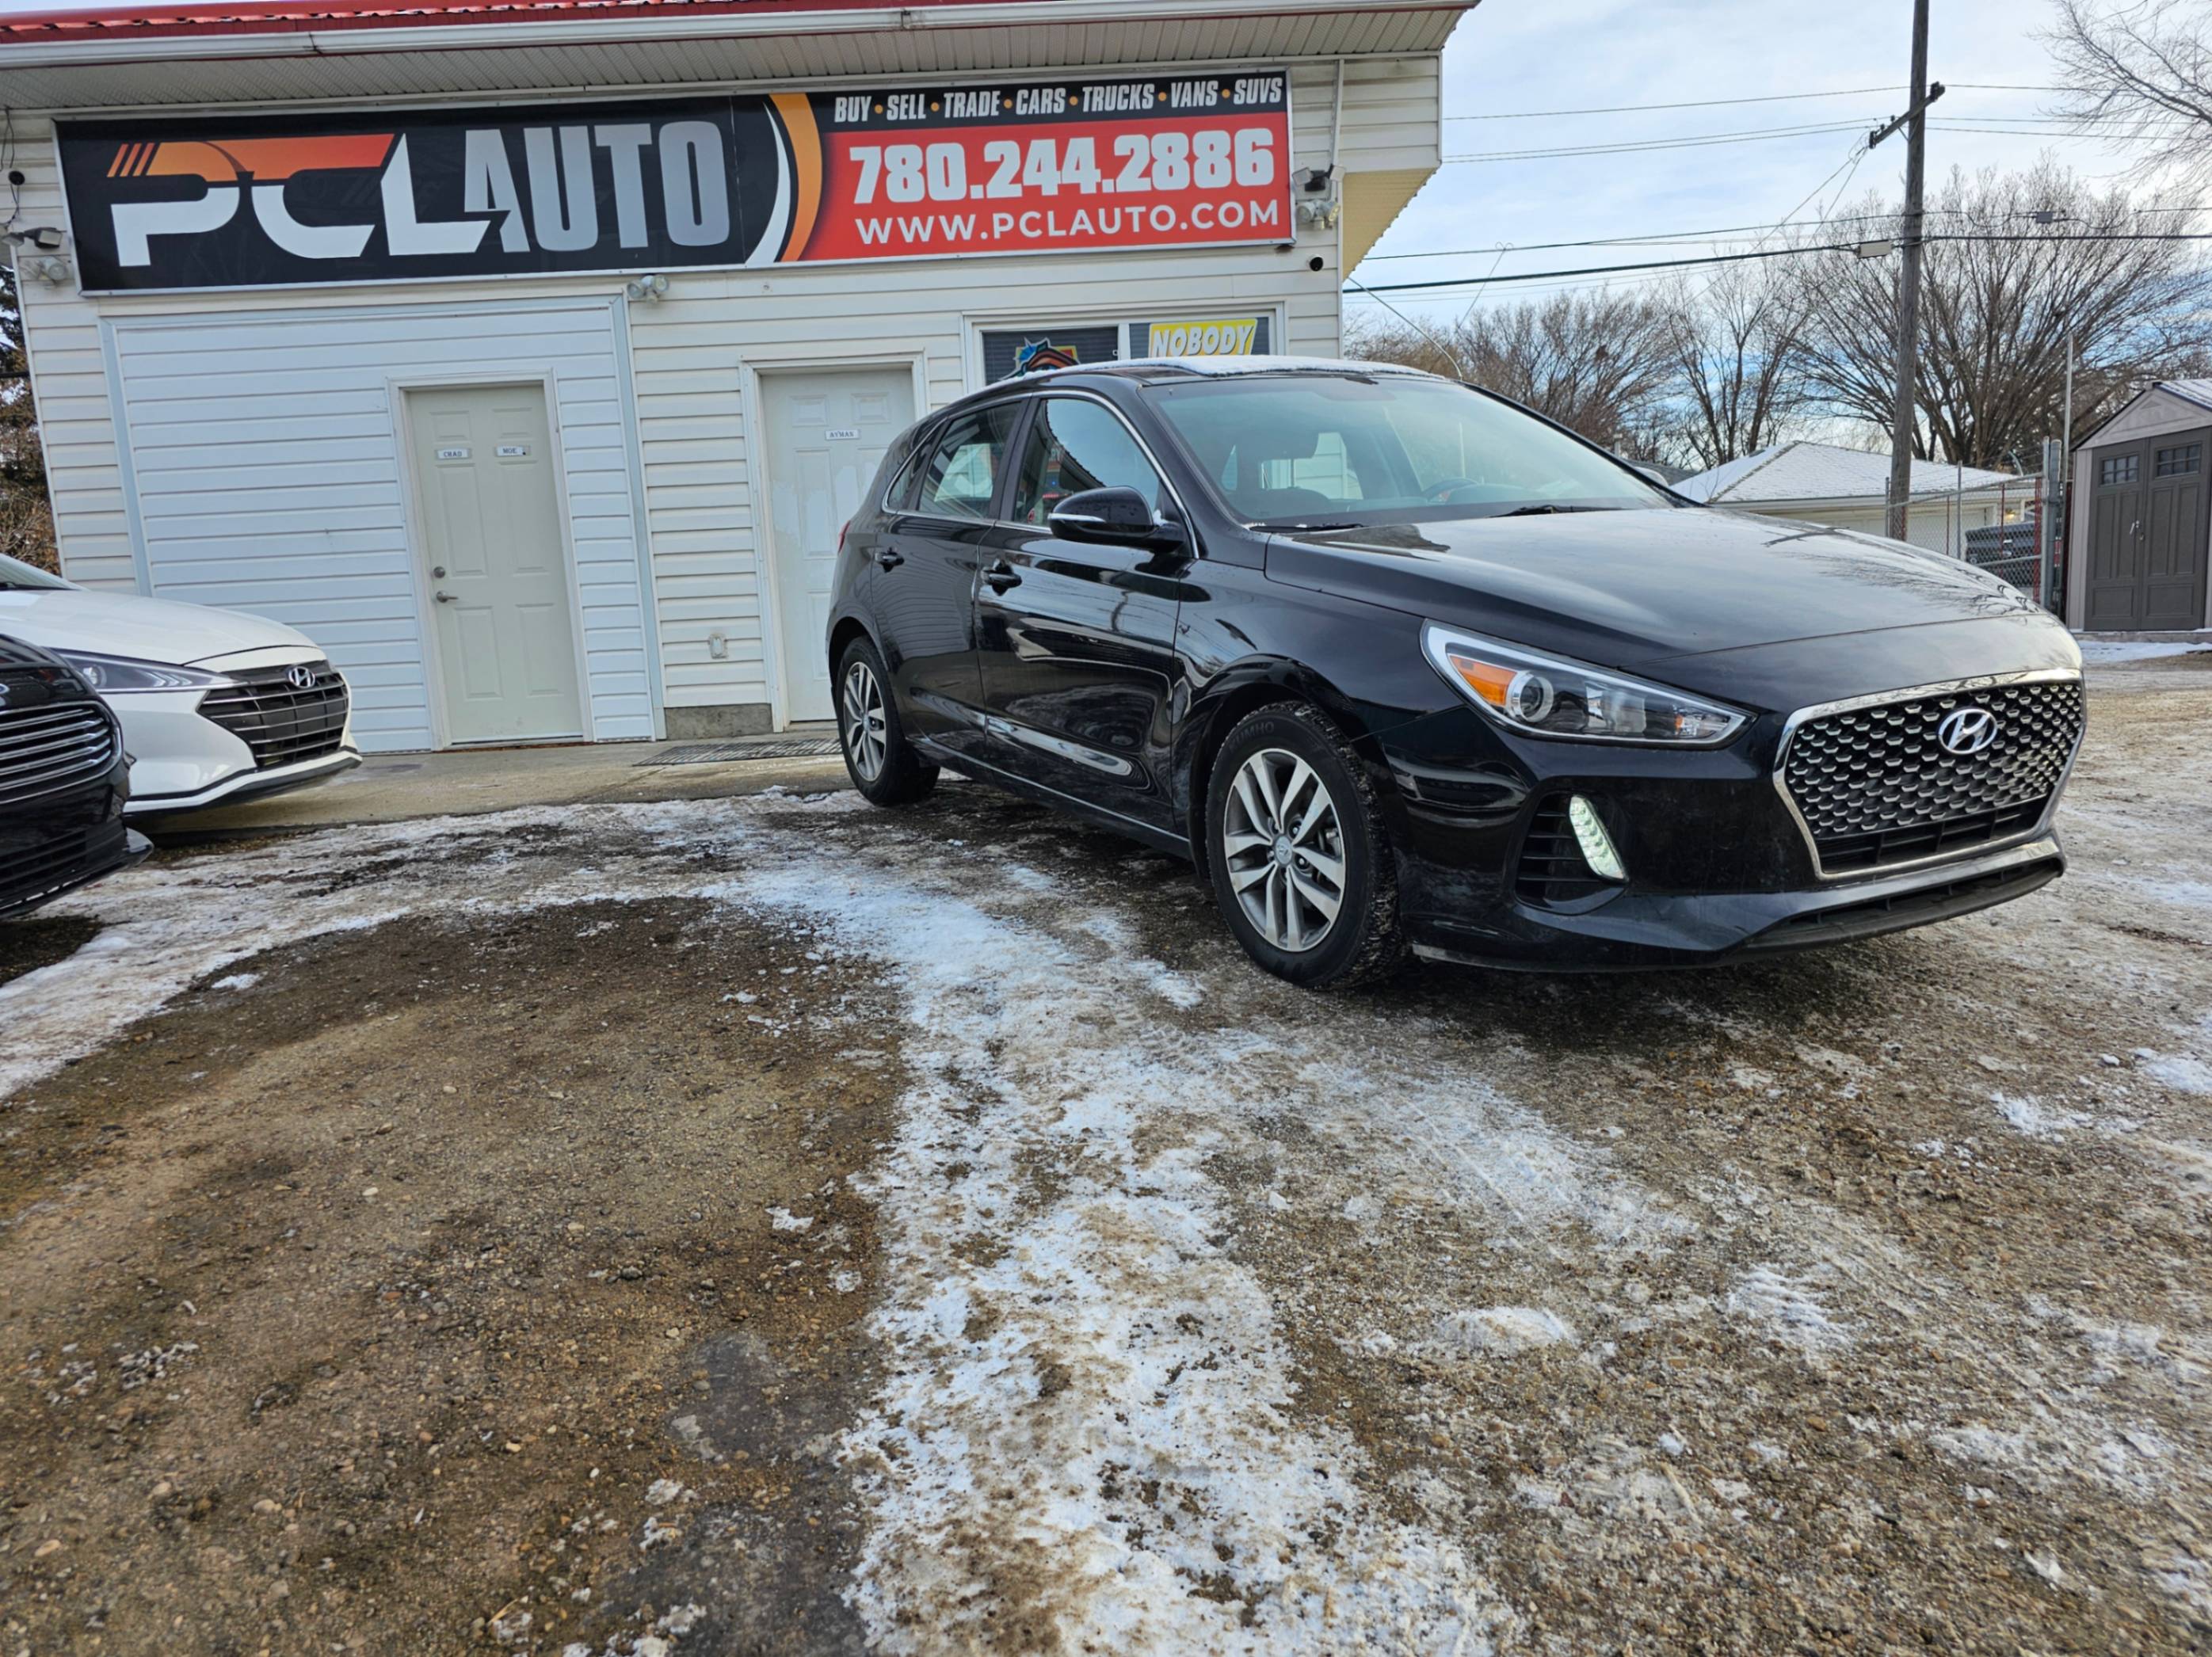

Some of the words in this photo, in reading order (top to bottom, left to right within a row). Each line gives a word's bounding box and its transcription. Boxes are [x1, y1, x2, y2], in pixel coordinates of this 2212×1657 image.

[834, 96, 871, 123] BUY
[887, 93, 926, 120] SELL
[944, 91, 1001, 118] TRADE
[1016, 88, 1066, 115] CARS
[1082, 84, 1155, 112] TRUCKS
[1171, 81, 1219, 108] VANS
[1233, 78, 1283, 105] SUVS
[464, 120, 730, 253] AUTO
[849, 128, 1274, 204] 780.244.2886
[855, 200, 1279, 245] WWW.PCLAUTO.COM
[1153, 326, 1253, 357] NOBODY
